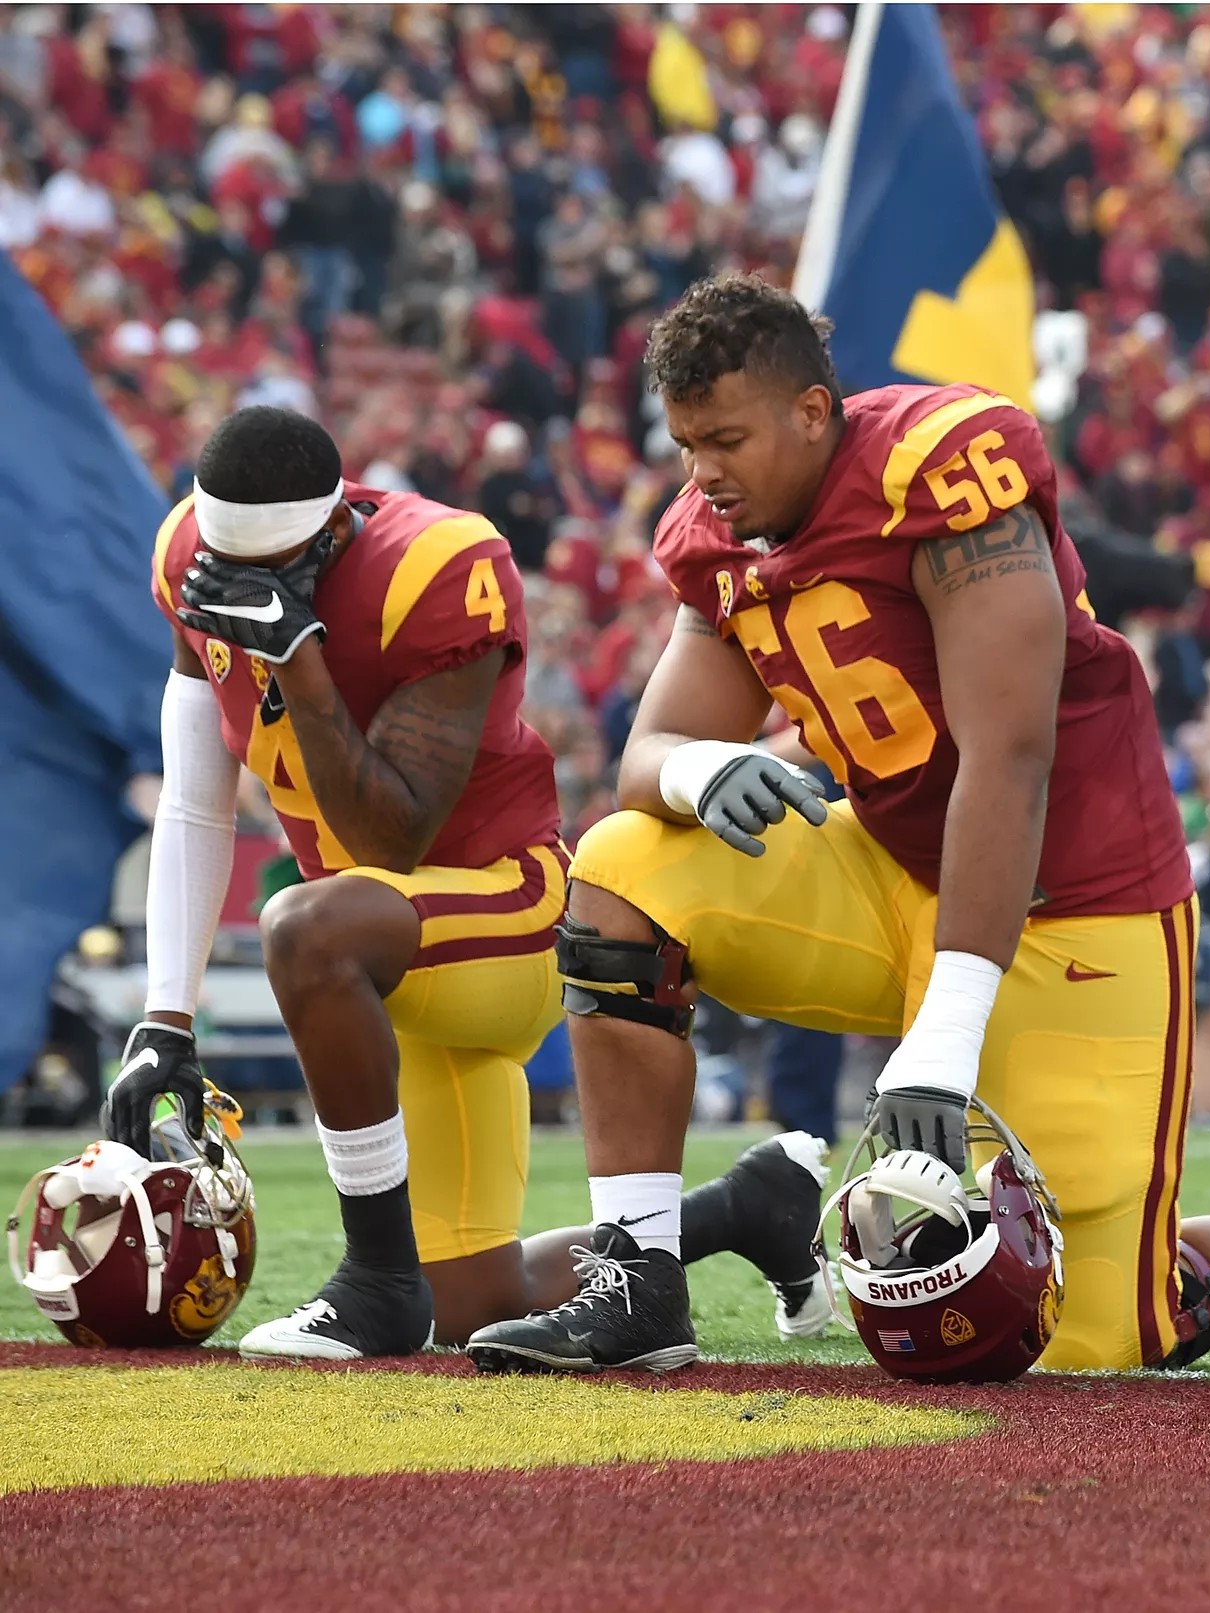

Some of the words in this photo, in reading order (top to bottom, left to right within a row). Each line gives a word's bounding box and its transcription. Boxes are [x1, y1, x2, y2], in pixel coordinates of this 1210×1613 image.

[922, 429, 1029, 531] 56
[464, 558, 506, 633] 4
[720, 580, 938, 785] 56
[246, 702, 358, 870] 4
[867, 1262, 968, 1301] TROJANS
